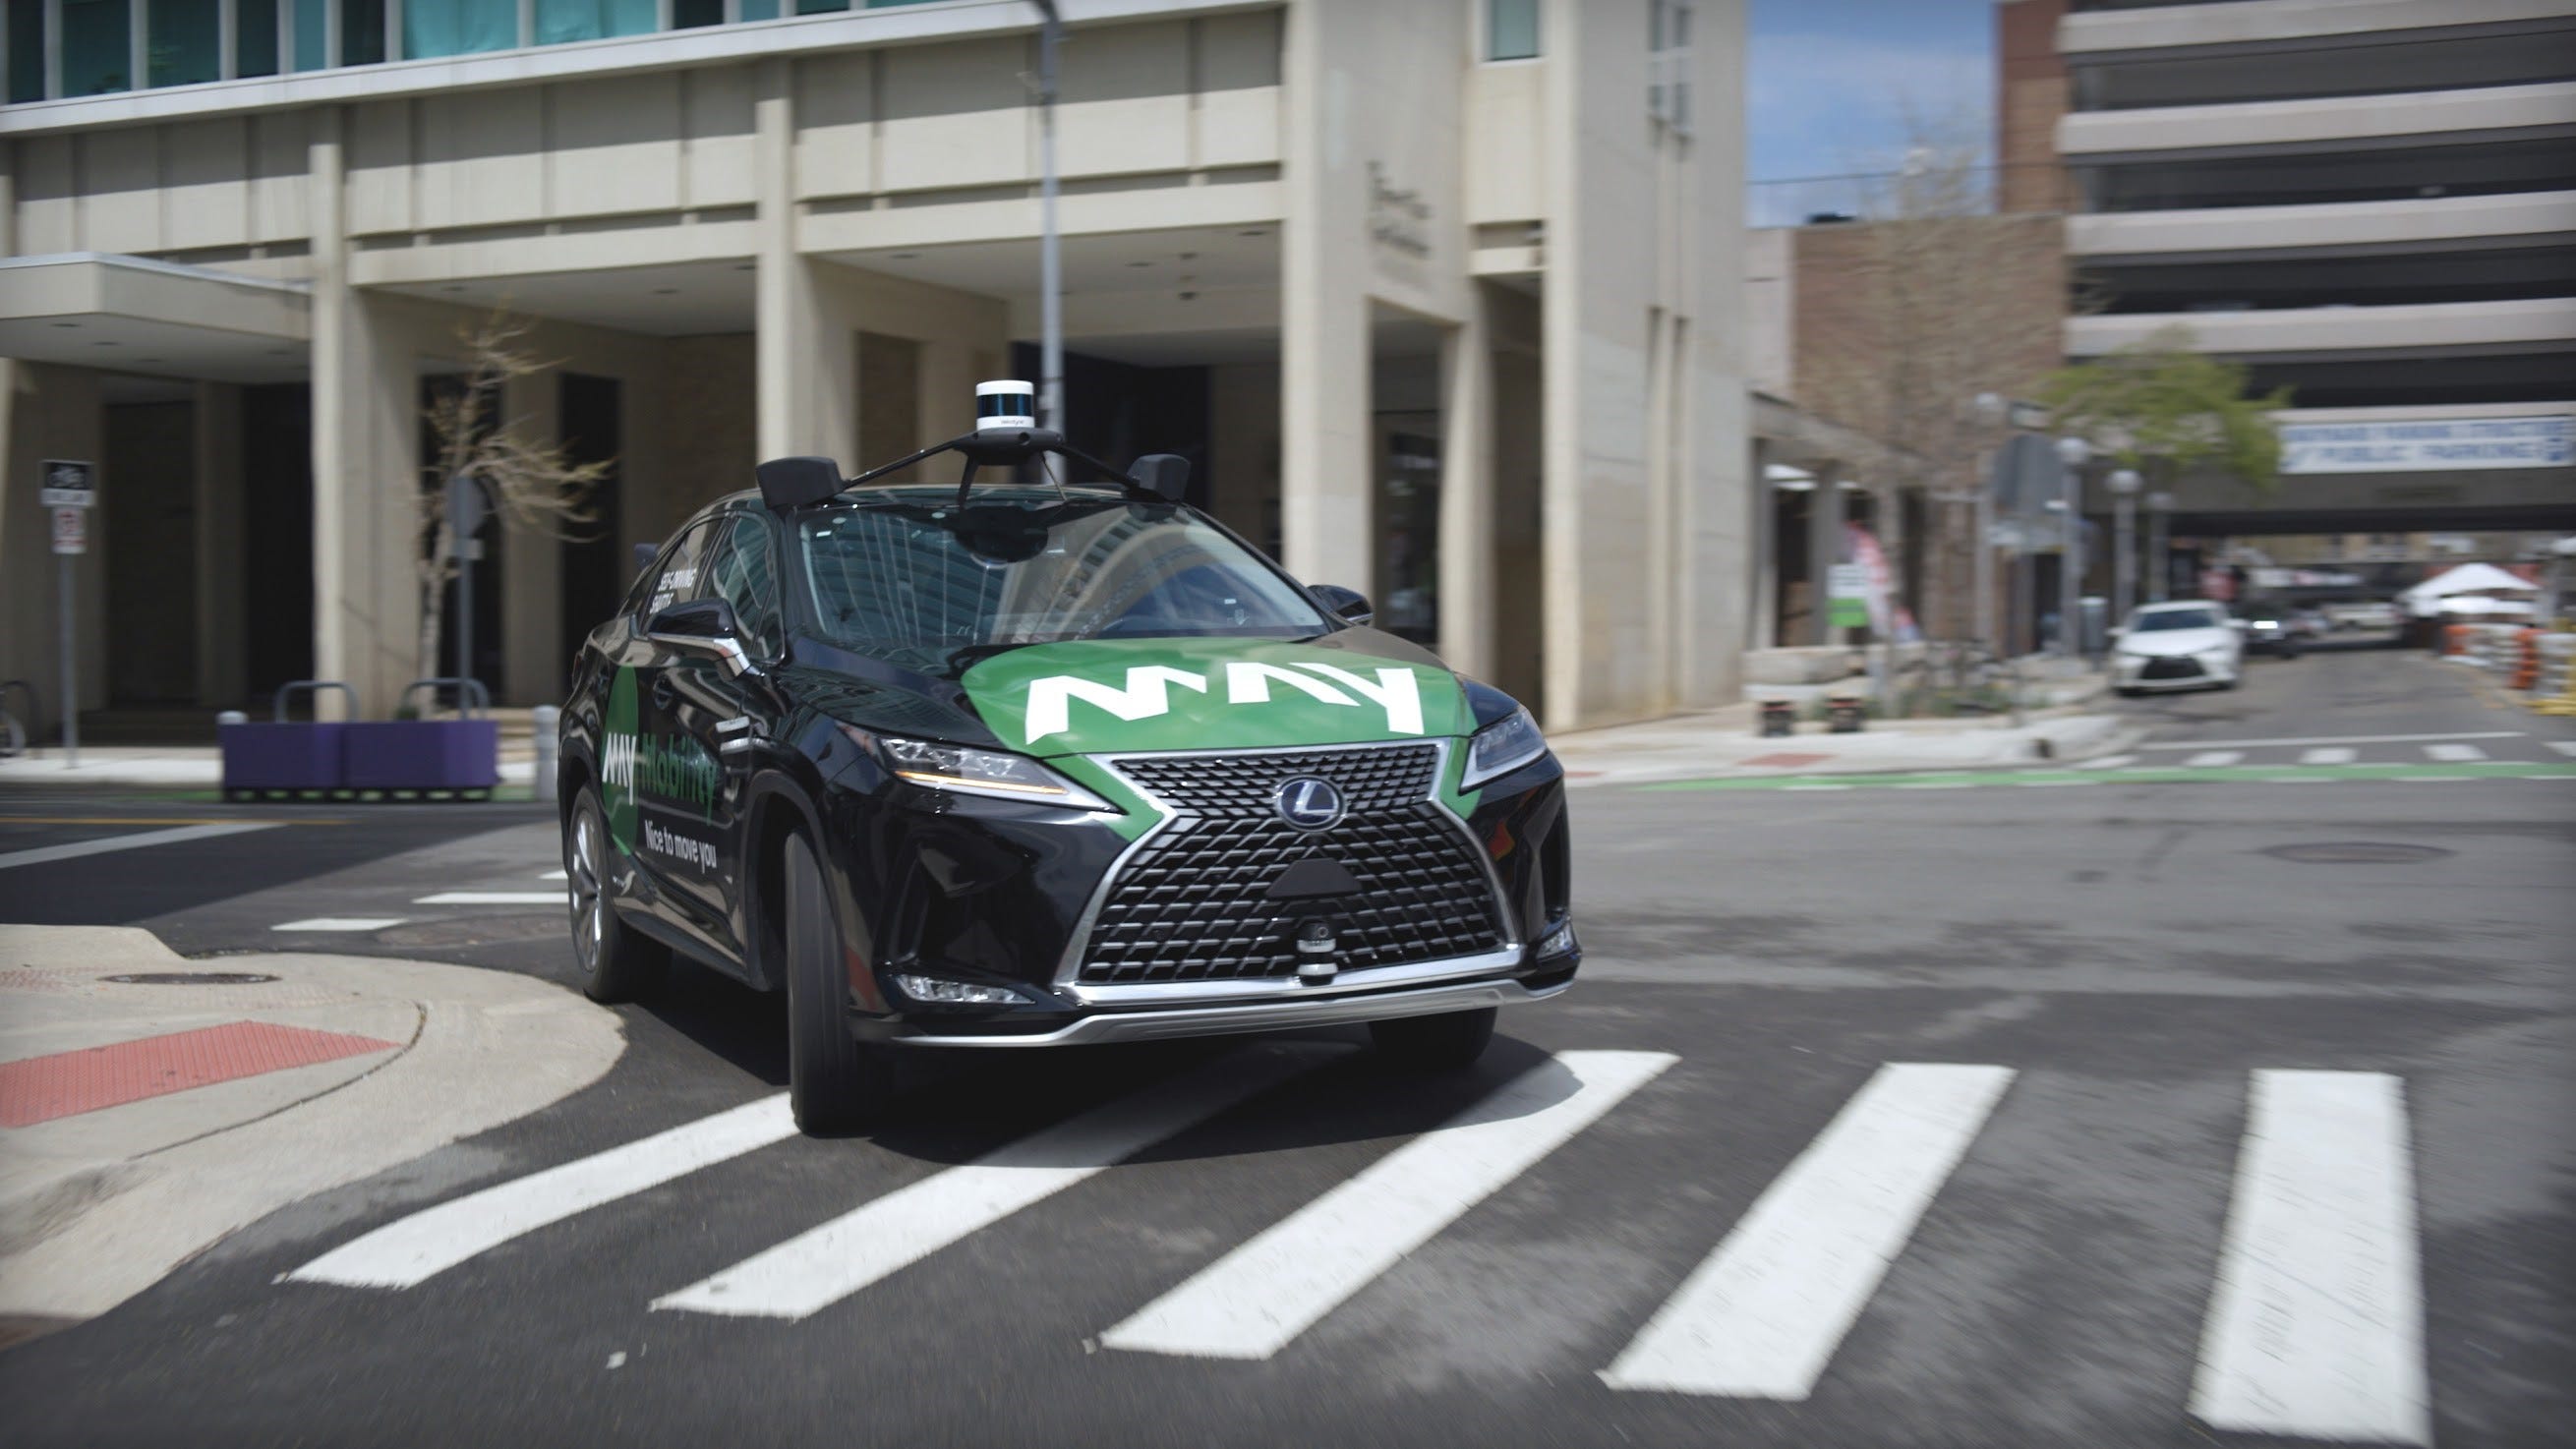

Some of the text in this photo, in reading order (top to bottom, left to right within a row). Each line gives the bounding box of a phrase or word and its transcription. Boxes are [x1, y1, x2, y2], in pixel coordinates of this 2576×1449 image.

[641, 732, 718, 826] Mobility
[645, 819, 718, 874] Nice to move you
